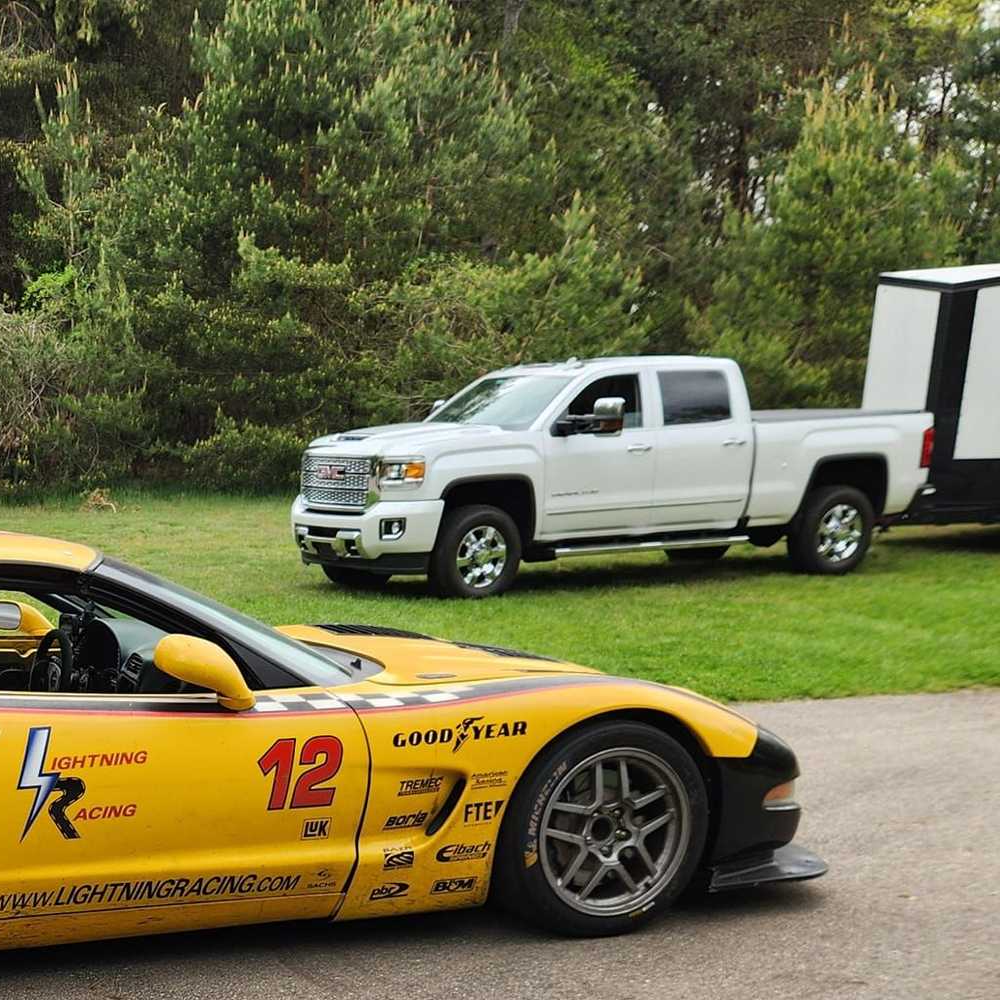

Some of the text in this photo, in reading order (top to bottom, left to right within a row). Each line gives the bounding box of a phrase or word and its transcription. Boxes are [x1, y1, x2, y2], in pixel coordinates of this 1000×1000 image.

[257, 735, 344, 811] 12
[399, 777, 443, 791] TREMEC
[464, 801, 492, 823] FTE
[436, 842, 490, 862] Eibach
